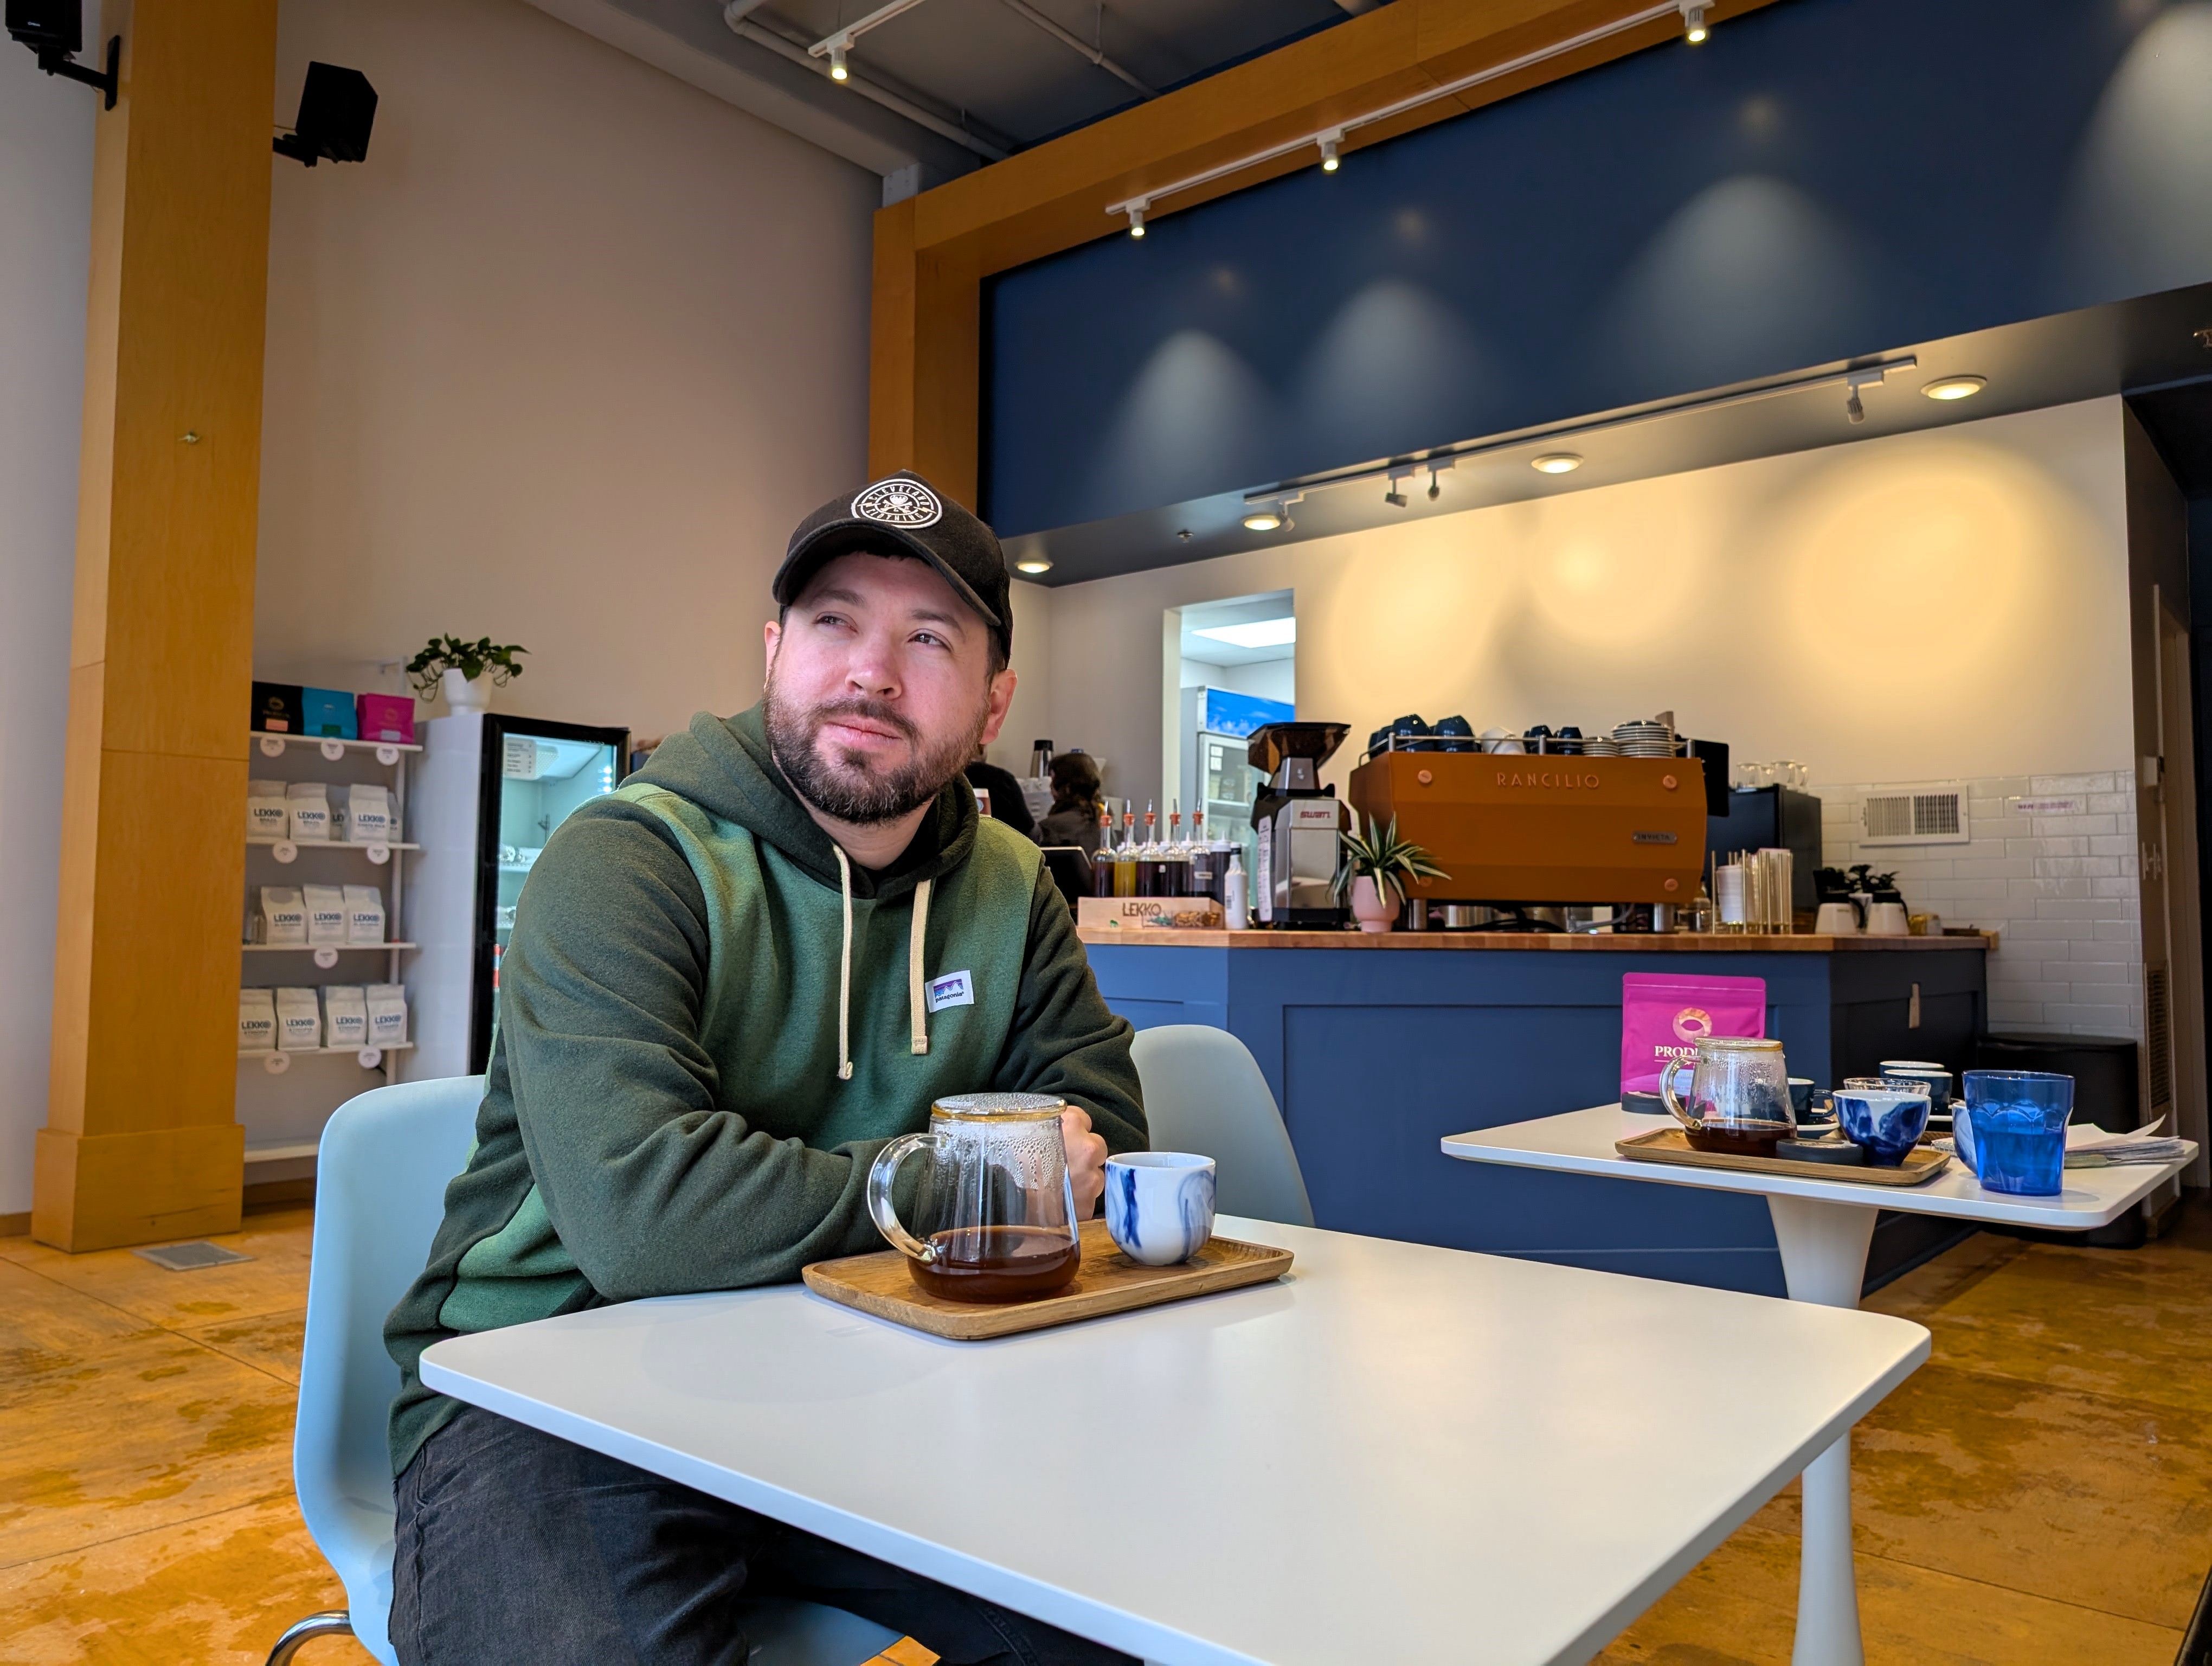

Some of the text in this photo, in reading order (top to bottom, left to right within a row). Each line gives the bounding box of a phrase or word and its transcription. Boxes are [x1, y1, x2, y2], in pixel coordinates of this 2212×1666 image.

[868, 485, 930, 505] CLEVELAND
[866, 508, 923, 522] CLOTHING
[1497, 772, 1599, 789] RANCILIO
[1122, 902, 1162, 917] LEKKO
